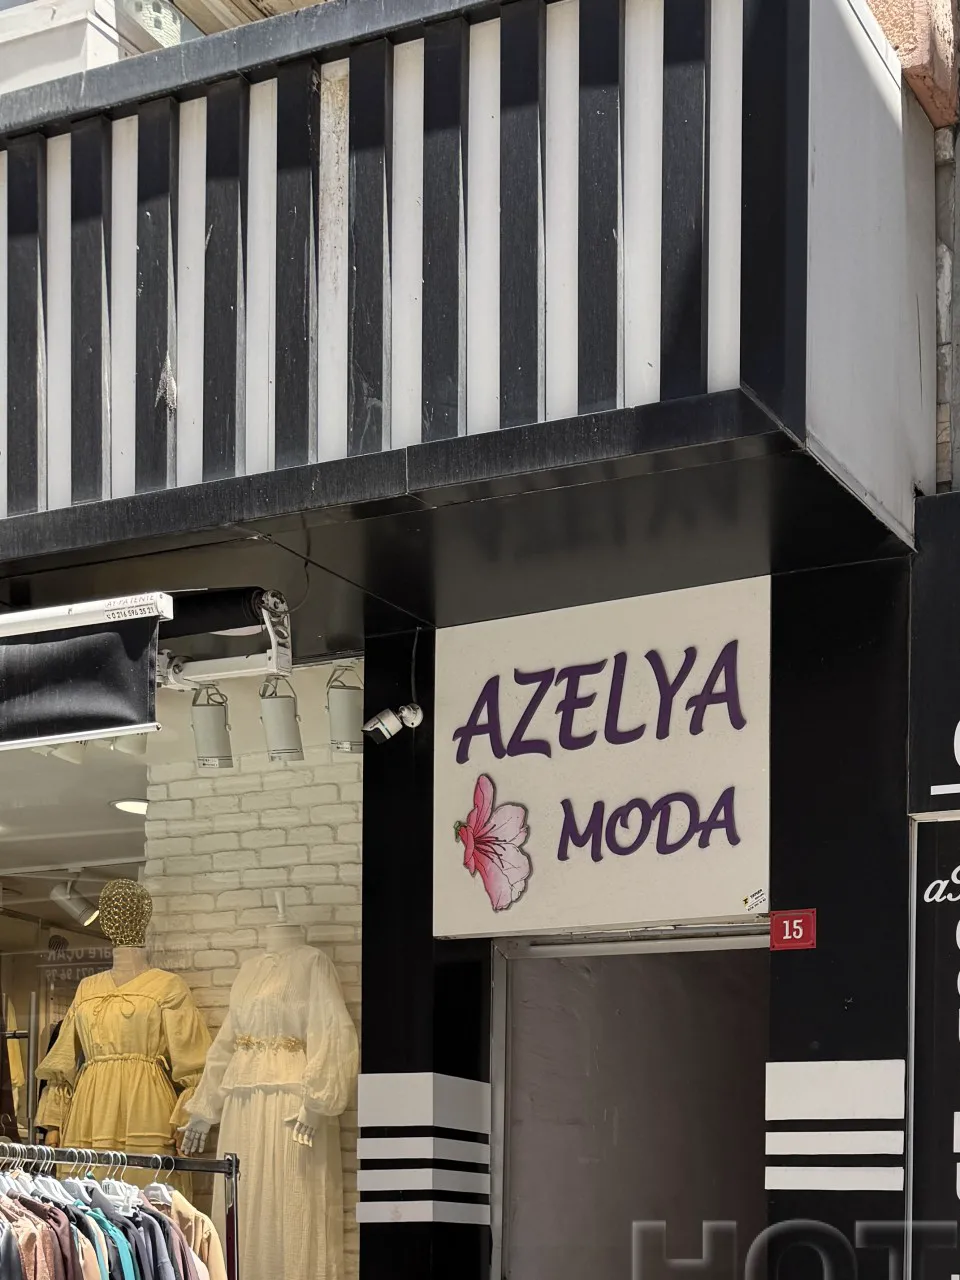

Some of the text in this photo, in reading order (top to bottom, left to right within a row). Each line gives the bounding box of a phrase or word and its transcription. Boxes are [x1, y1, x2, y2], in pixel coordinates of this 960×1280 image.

[451, 639, 748, 765] AZELYA
[556, 785, 741, 863] MODA
[782, 919, 804, 940] 15
